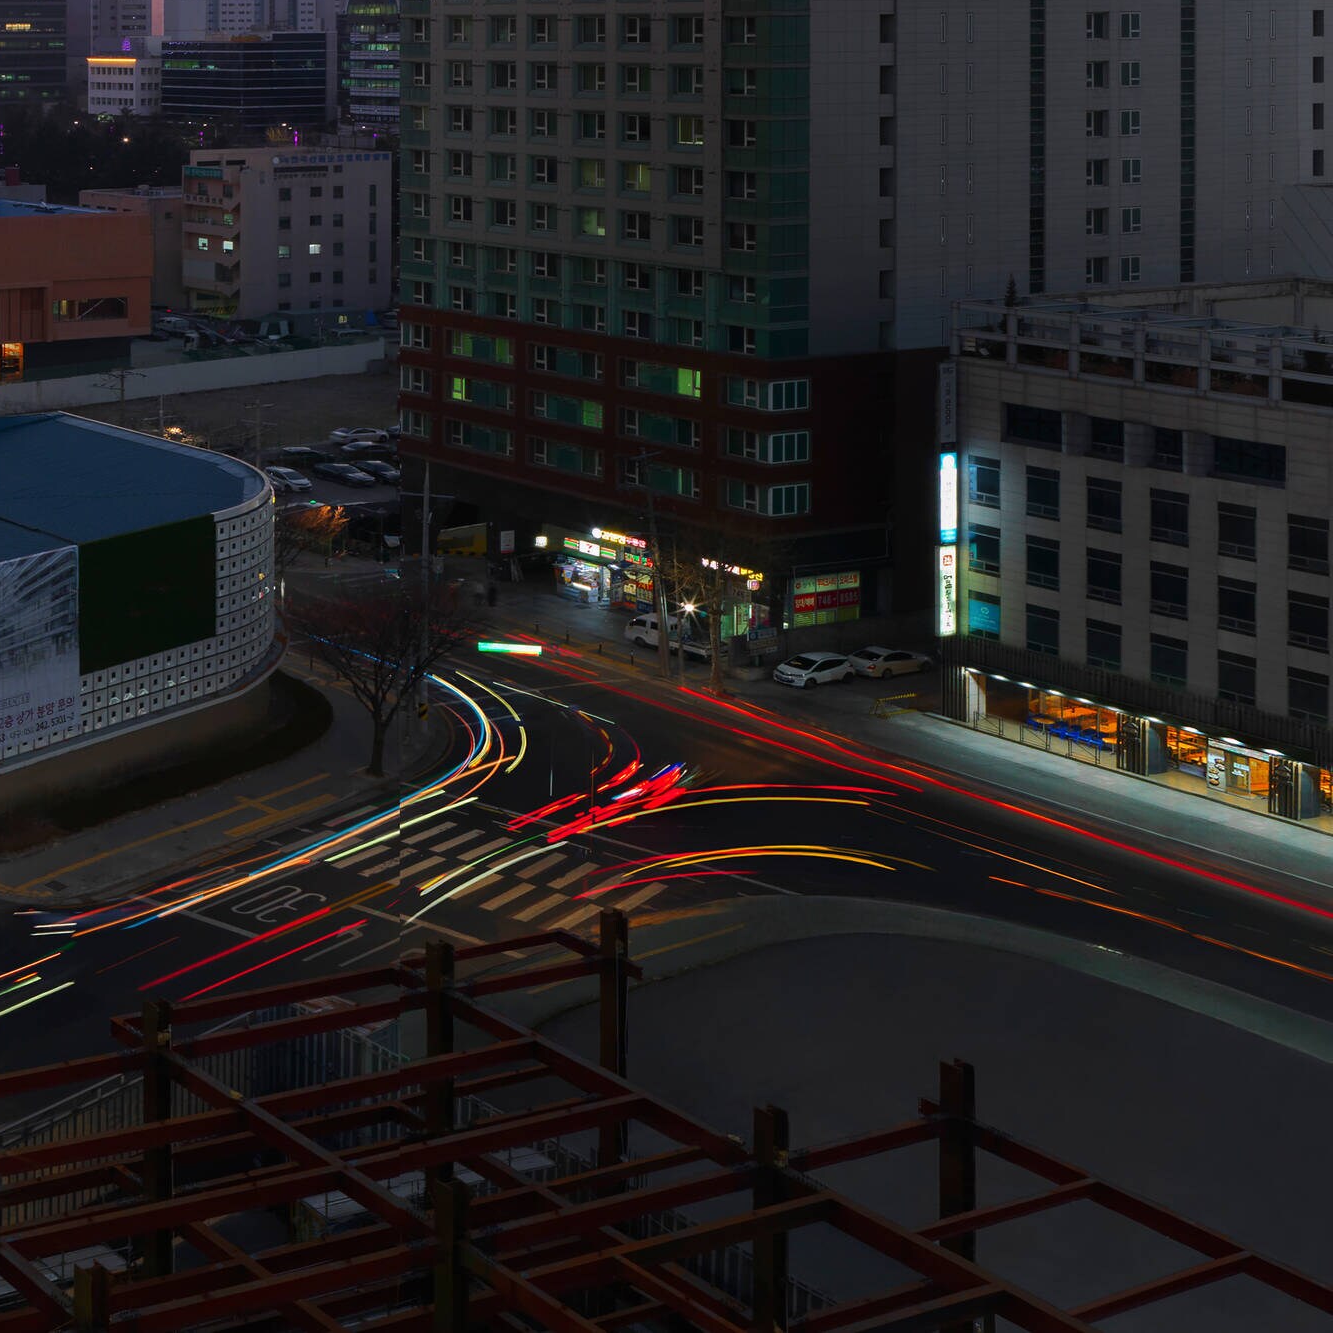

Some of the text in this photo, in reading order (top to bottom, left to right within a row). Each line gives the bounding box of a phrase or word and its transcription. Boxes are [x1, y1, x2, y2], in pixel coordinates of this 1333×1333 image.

[36, 702, 55, 719] 분양
[58, 697, 76, 712] 문의
[230, 884, 328, 924] 30
